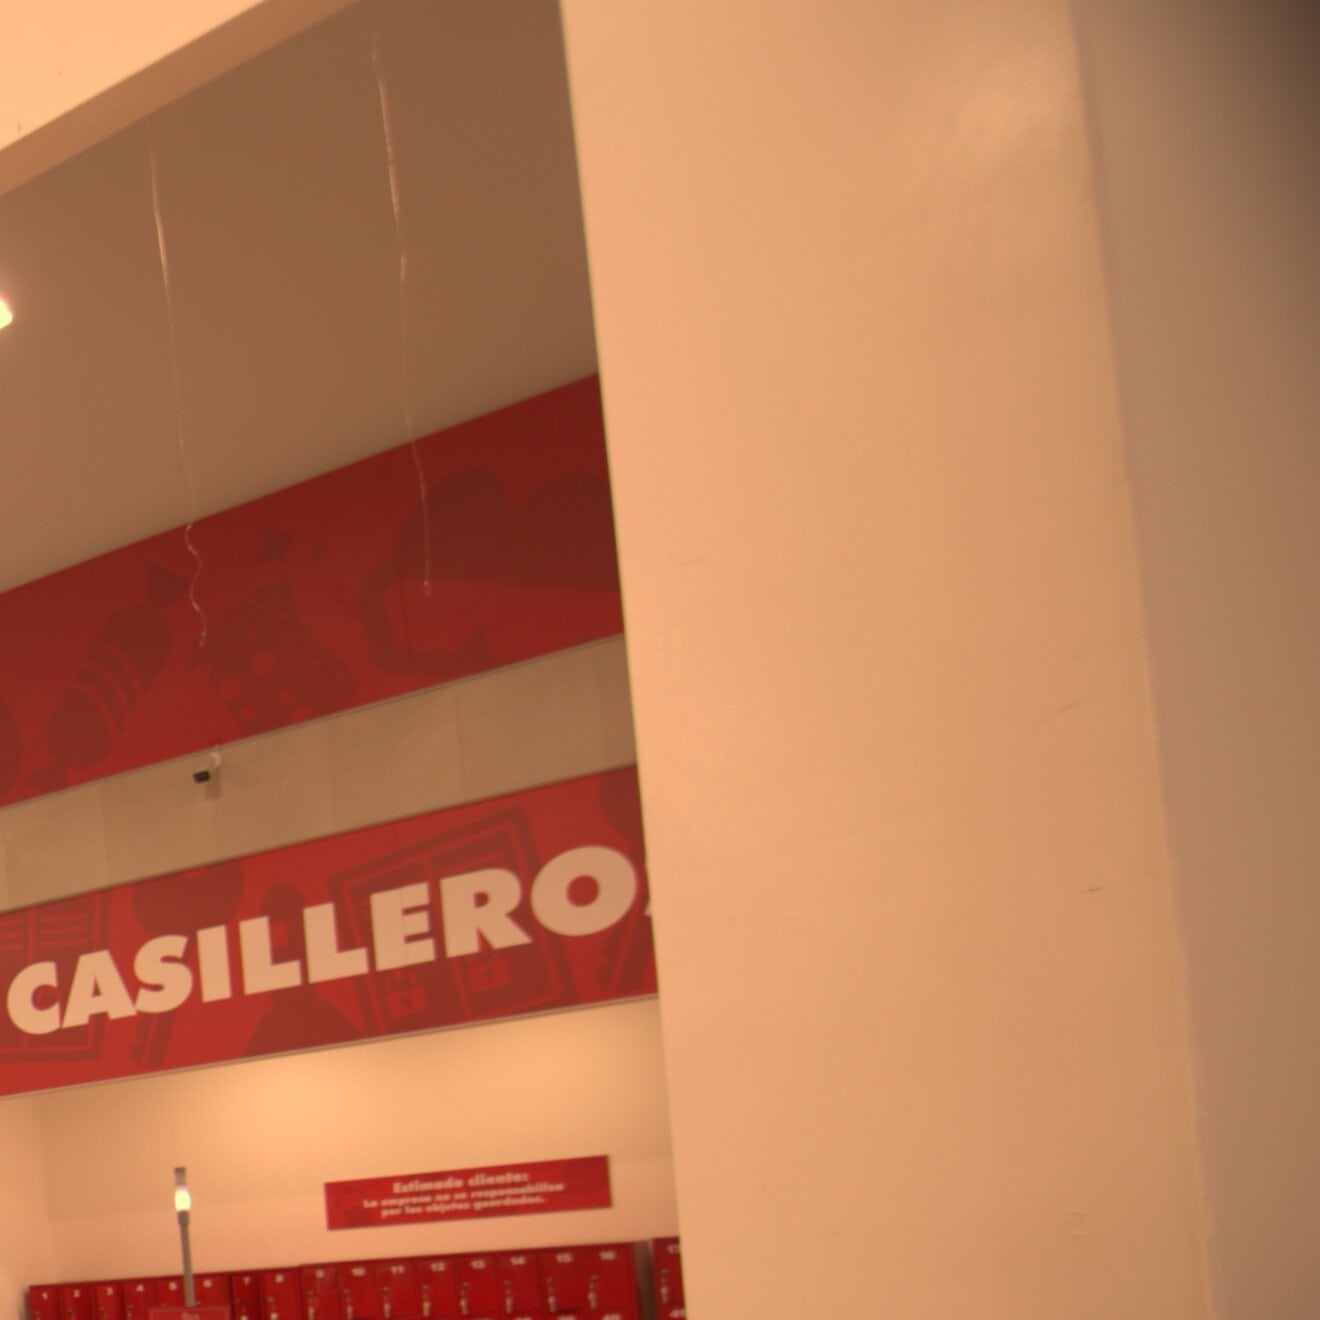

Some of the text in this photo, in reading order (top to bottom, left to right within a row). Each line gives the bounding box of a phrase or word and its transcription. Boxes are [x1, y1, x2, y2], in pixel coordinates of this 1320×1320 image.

[6, 844, 652, 1035] CASILLERO
[392, 1172, 530, 1194] Estimado cliente:
[390, 1265, 404, 1274] 11
[430, 1262, 446, 1272] 12
[471, 1260, 486, 1270] 13
